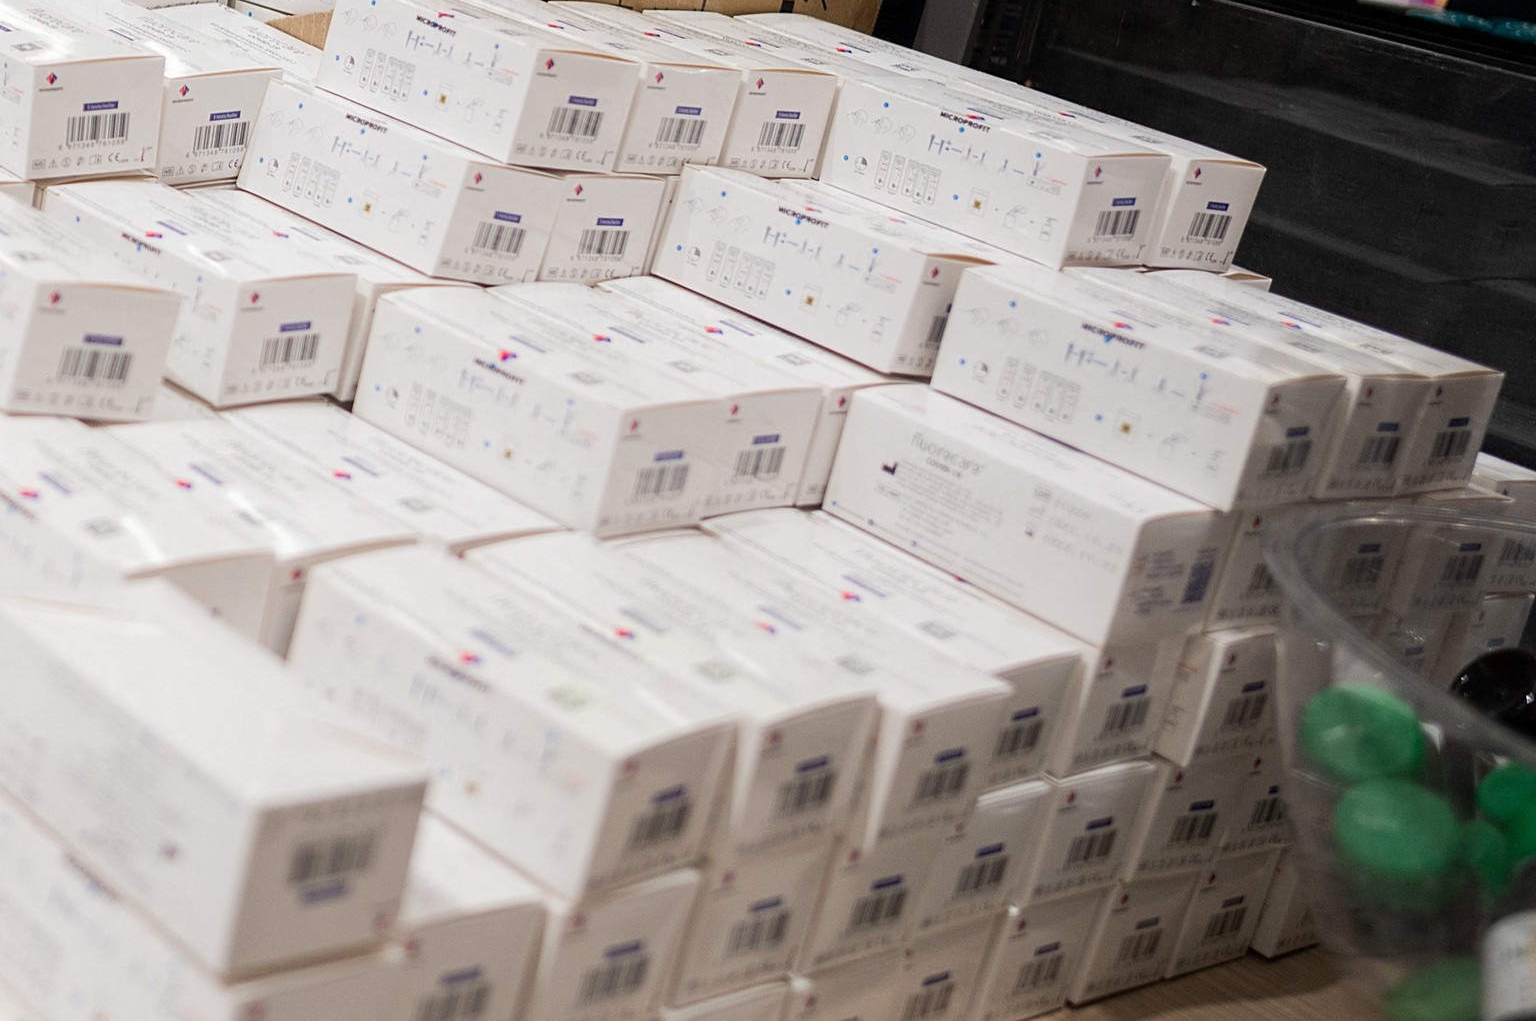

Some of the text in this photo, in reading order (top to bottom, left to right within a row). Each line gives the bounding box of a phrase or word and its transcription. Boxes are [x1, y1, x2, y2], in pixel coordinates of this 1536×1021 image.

[416, 14, 457, 38] MICROPROFIT
[345, 113, 388, 134] MICROPROFIT
[940, 111, 991, 134] MICROPROFIT
[777, 205, 829, 229] MICROPROFIT
